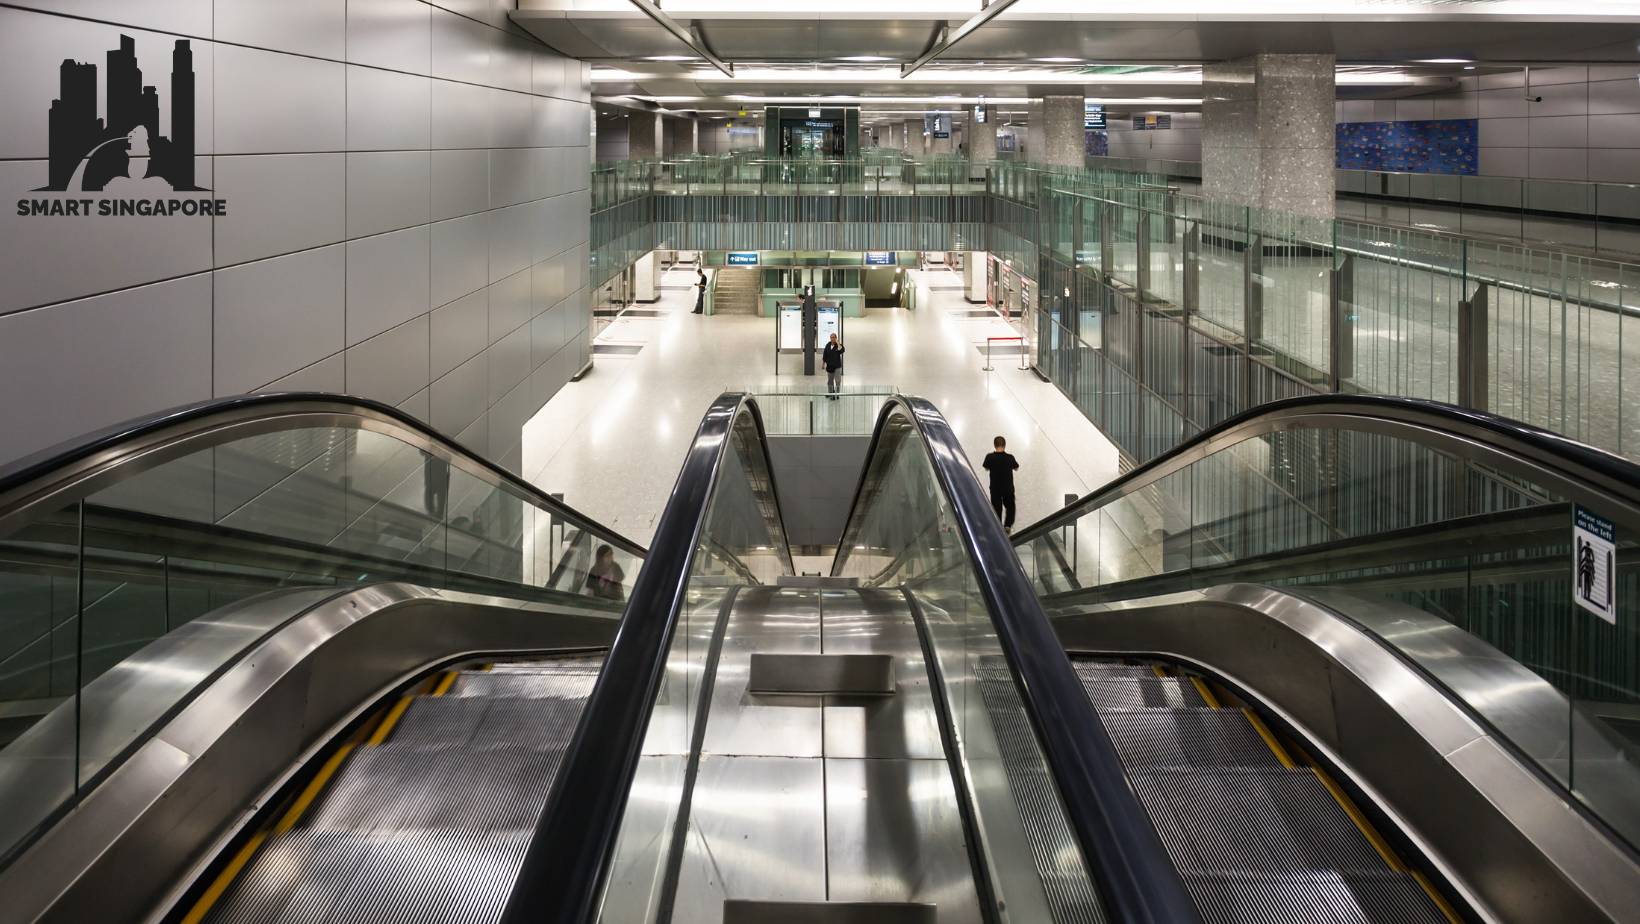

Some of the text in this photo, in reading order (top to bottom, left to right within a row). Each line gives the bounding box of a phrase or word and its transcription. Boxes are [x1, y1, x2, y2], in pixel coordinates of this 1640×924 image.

[1578, 510, 1612, 531] Please stand
[1578, 519, 1612, 541] on the left
